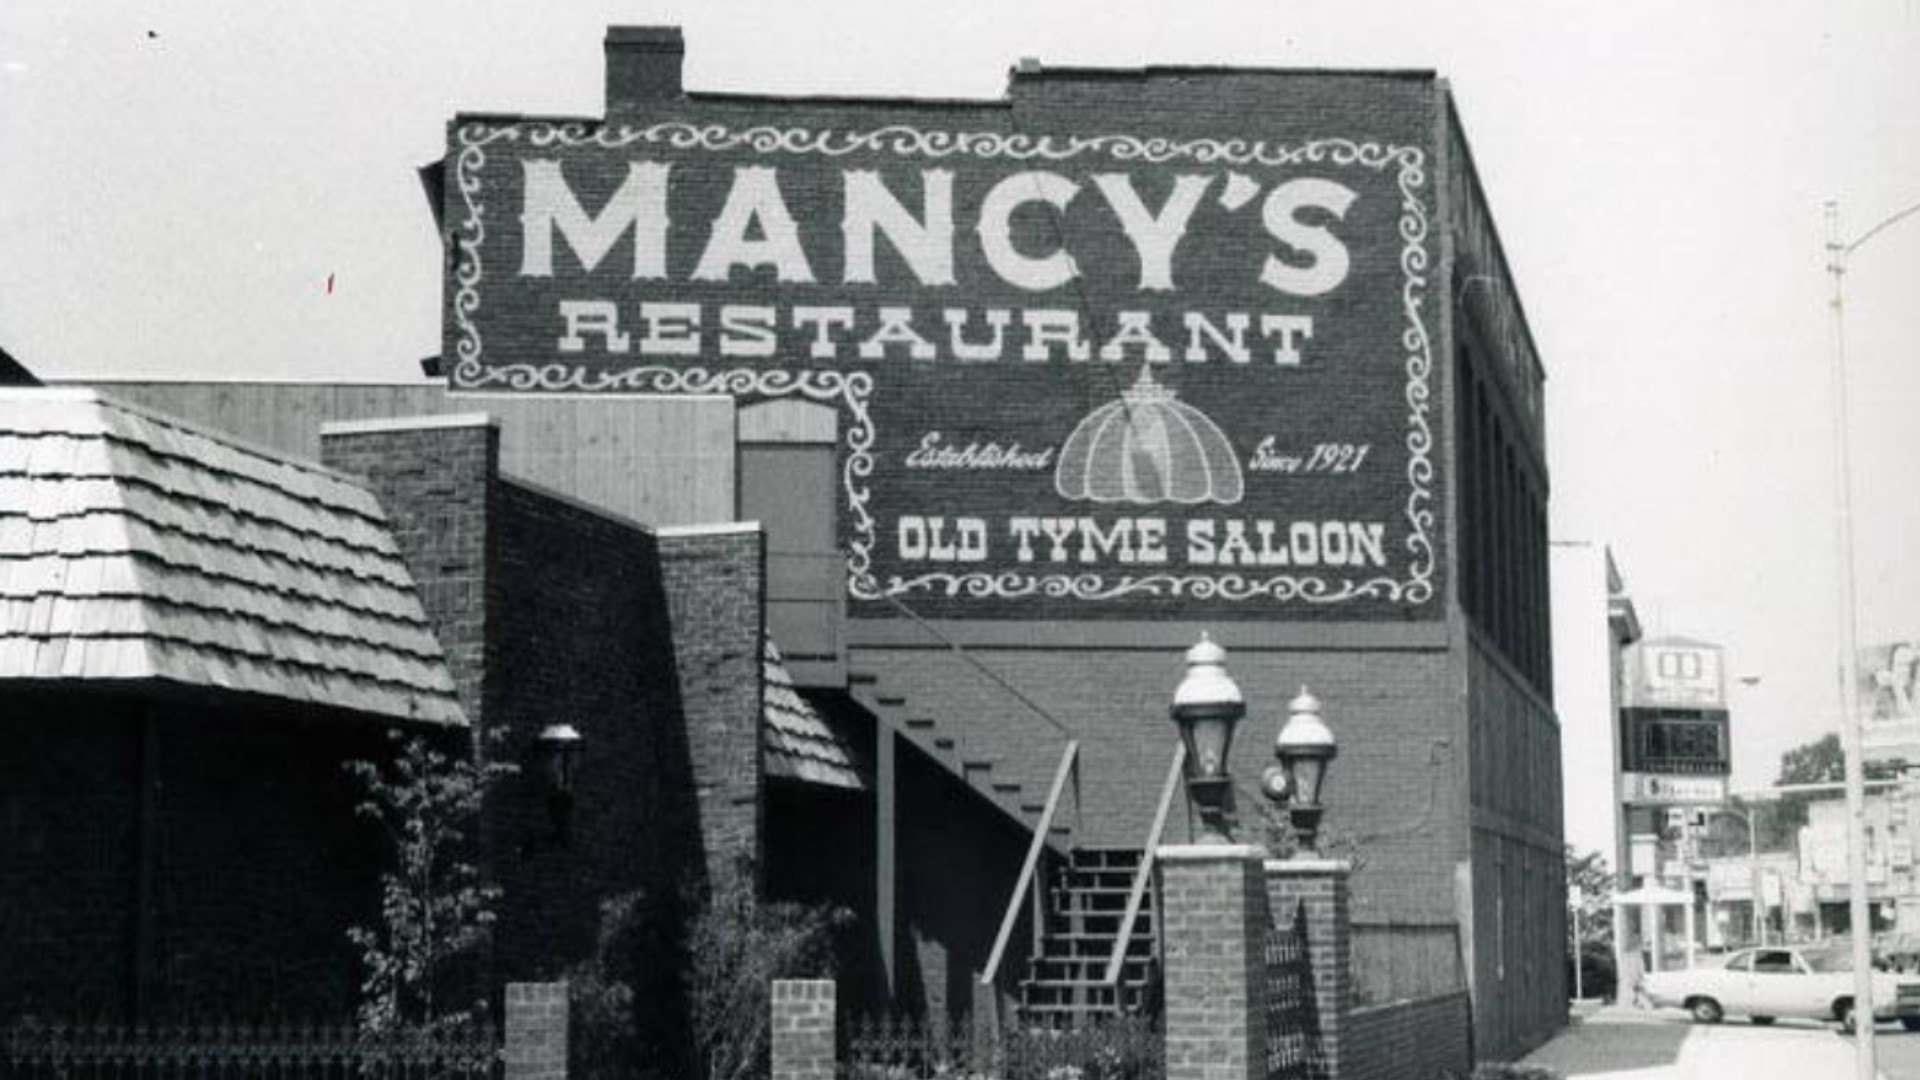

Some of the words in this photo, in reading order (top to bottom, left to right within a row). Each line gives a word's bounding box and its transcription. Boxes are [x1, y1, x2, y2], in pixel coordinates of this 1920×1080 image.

[520, 158, 1359, 296] MANCY'S
[558, 301, 1313, 364] RESTAURANT
[905, 431, 1054, 468] Established
[1249, 435, 1302, 473] Since
[1305, 443, 1370, 472] 1921
[899, 516, 987, 561] OLD
[1010, 517, 1167, 562] TYME
[1187, 519, 1385, 566] SALOON
